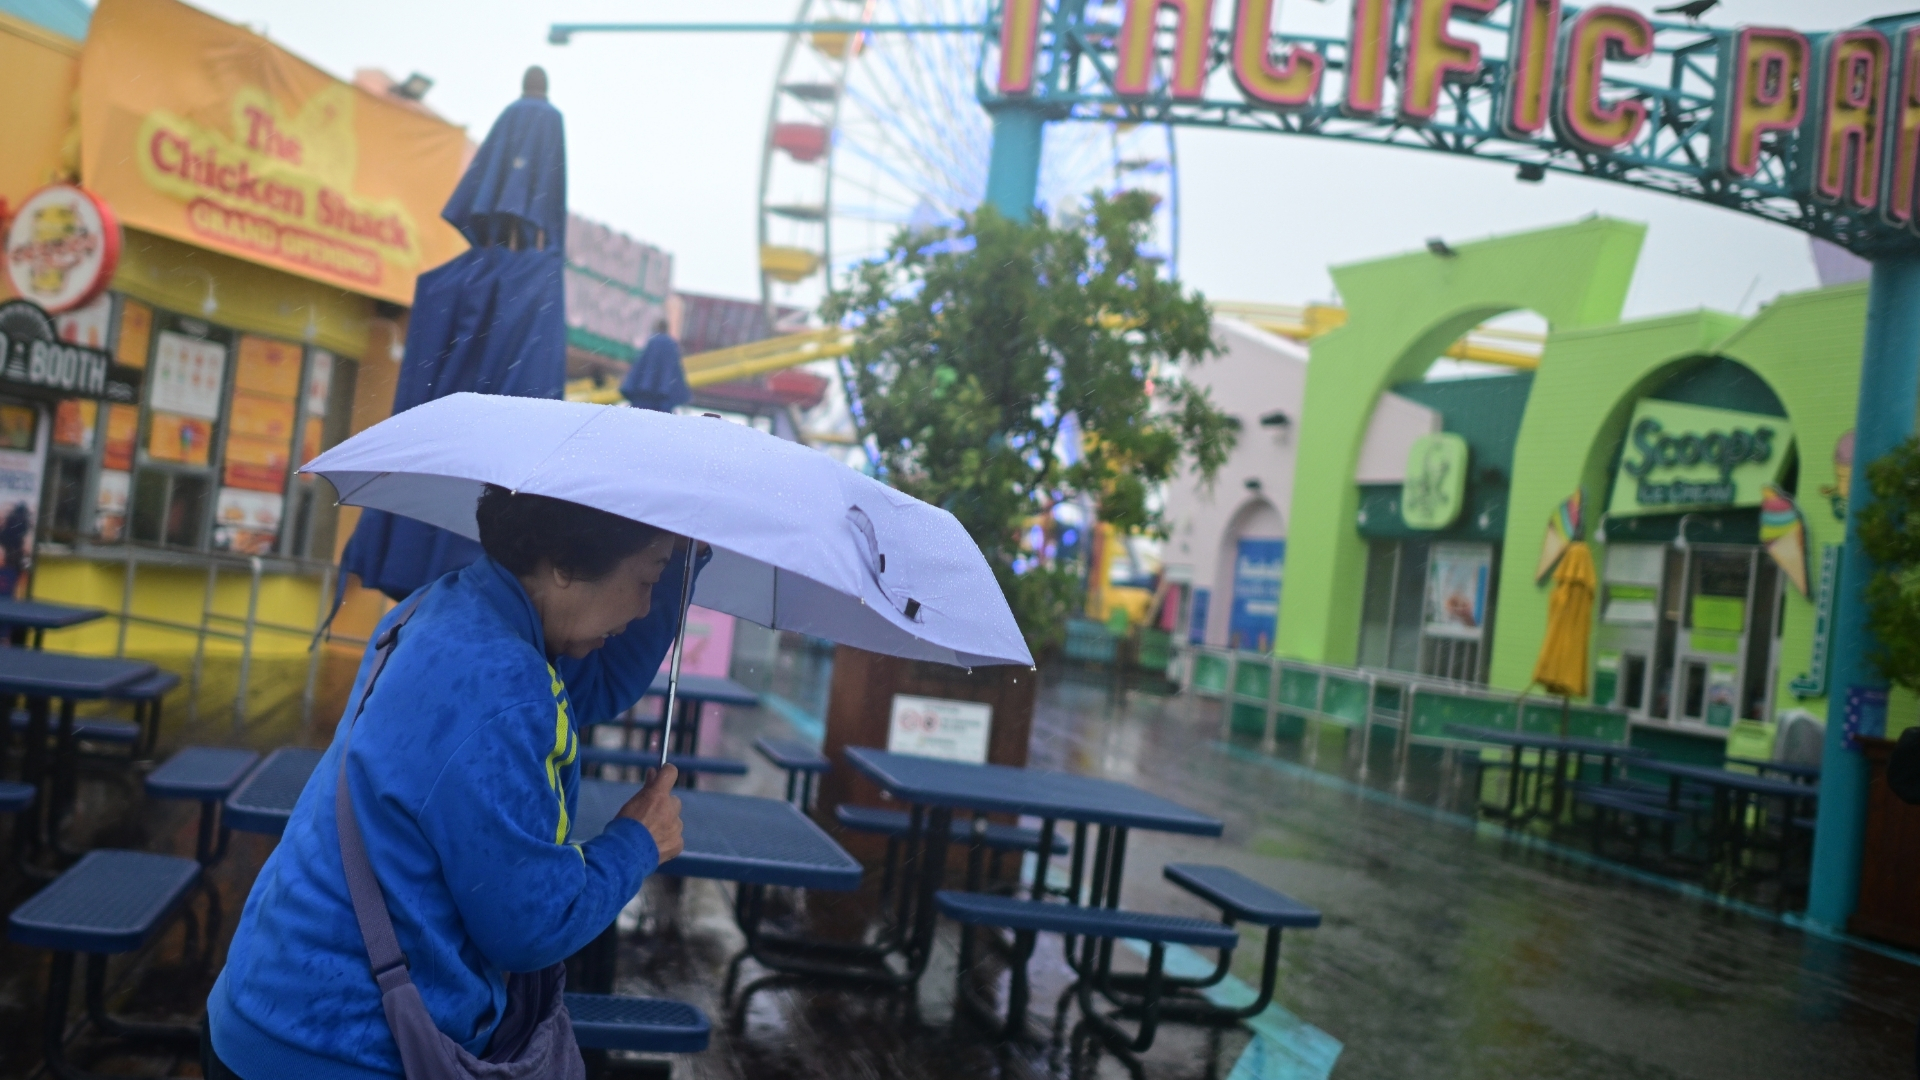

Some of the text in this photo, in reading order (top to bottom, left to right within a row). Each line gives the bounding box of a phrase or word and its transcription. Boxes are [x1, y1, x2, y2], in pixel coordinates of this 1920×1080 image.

[244, 103, 302, 165] The
[150, 127, 410, 250] Chicken Shack
[29, 339, 108, 395] BOOTH
[1624, 418, 1775, 485] Scoops
